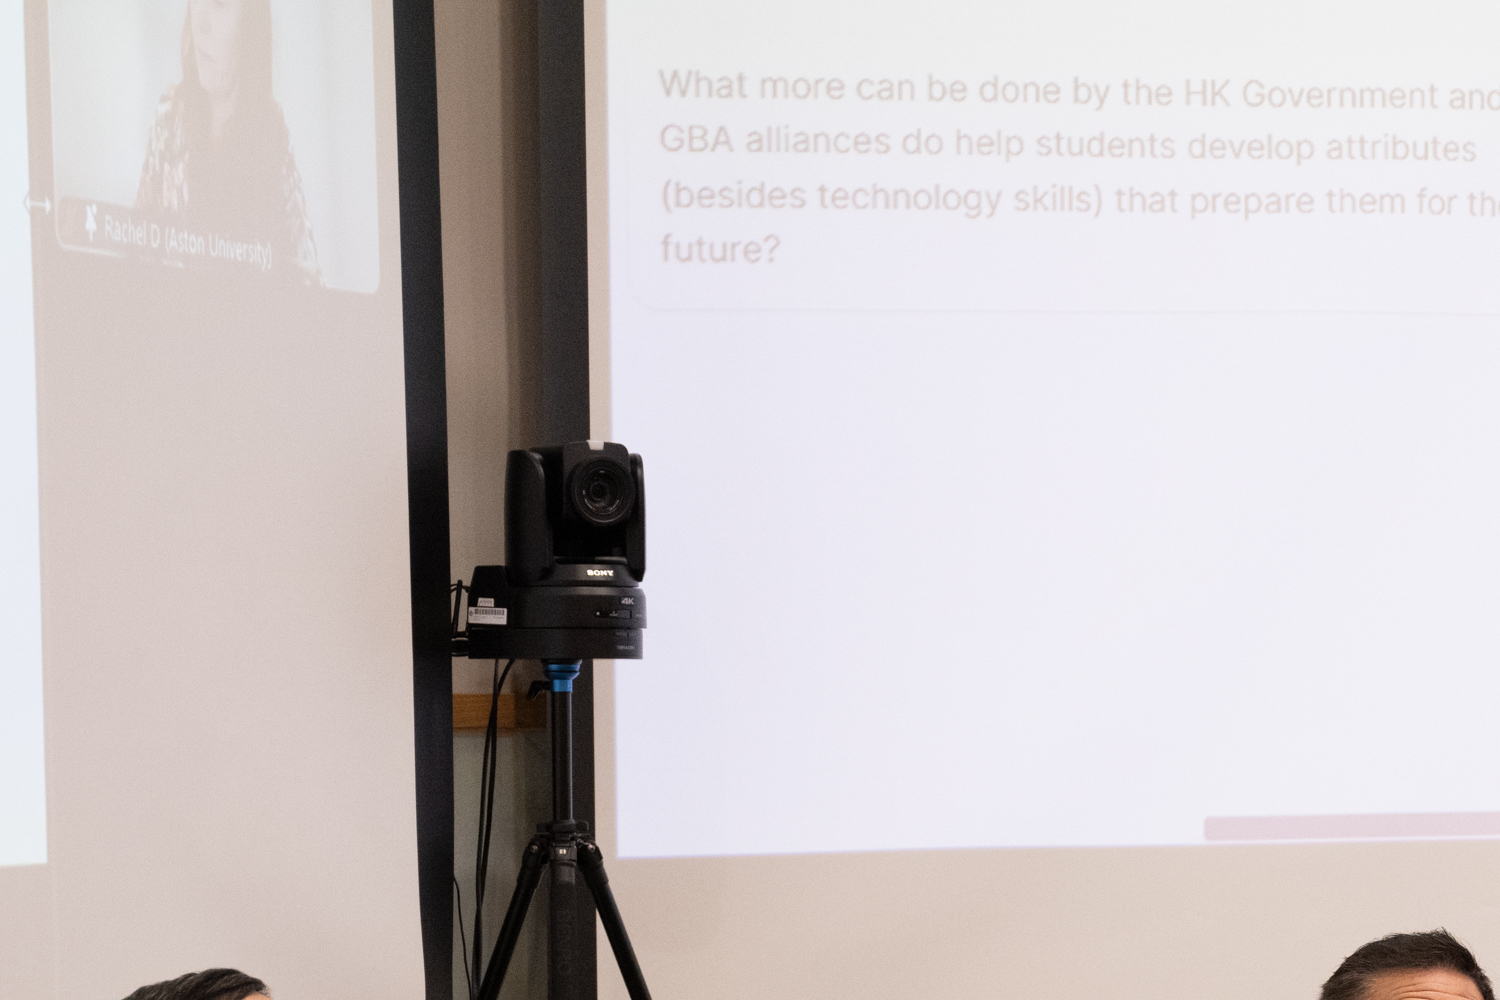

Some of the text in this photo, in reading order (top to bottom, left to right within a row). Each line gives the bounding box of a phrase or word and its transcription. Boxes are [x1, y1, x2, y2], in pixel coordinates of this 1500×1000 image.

[659, 70, 746, 98] What
[761, 77, 845, 99] more
[856, 79, 914, 100] can
[928, 75, 967, 101] be
[979, 76, 1060, 103] done
[1074, 77, 1109, 110] by
[1122, 79, 1172, 105] the
[1186, 80, 1229, 106] HK
[1243, 80, 1437, 108] Government
[660, 124, 1475, 165] GBA alliances do help students develop attributes
[663, 180, 806, 213] (besides
[818, 184, 1001, 218] technology
[1015, 185, 1101, 217] skills)
[1116, 188, 1177, 212] that
[1191, 193, 1314, 219] prepare
[1327, 190, 1404, 213] them
[1418, 188, 1457, 214] for
[104, 214, 272, 272] Rachel D (Aston University)
[662, 234, 780, 263] future?
[587, 569, 614, 577] SONY
[621, 597, 635, 605] 4K
